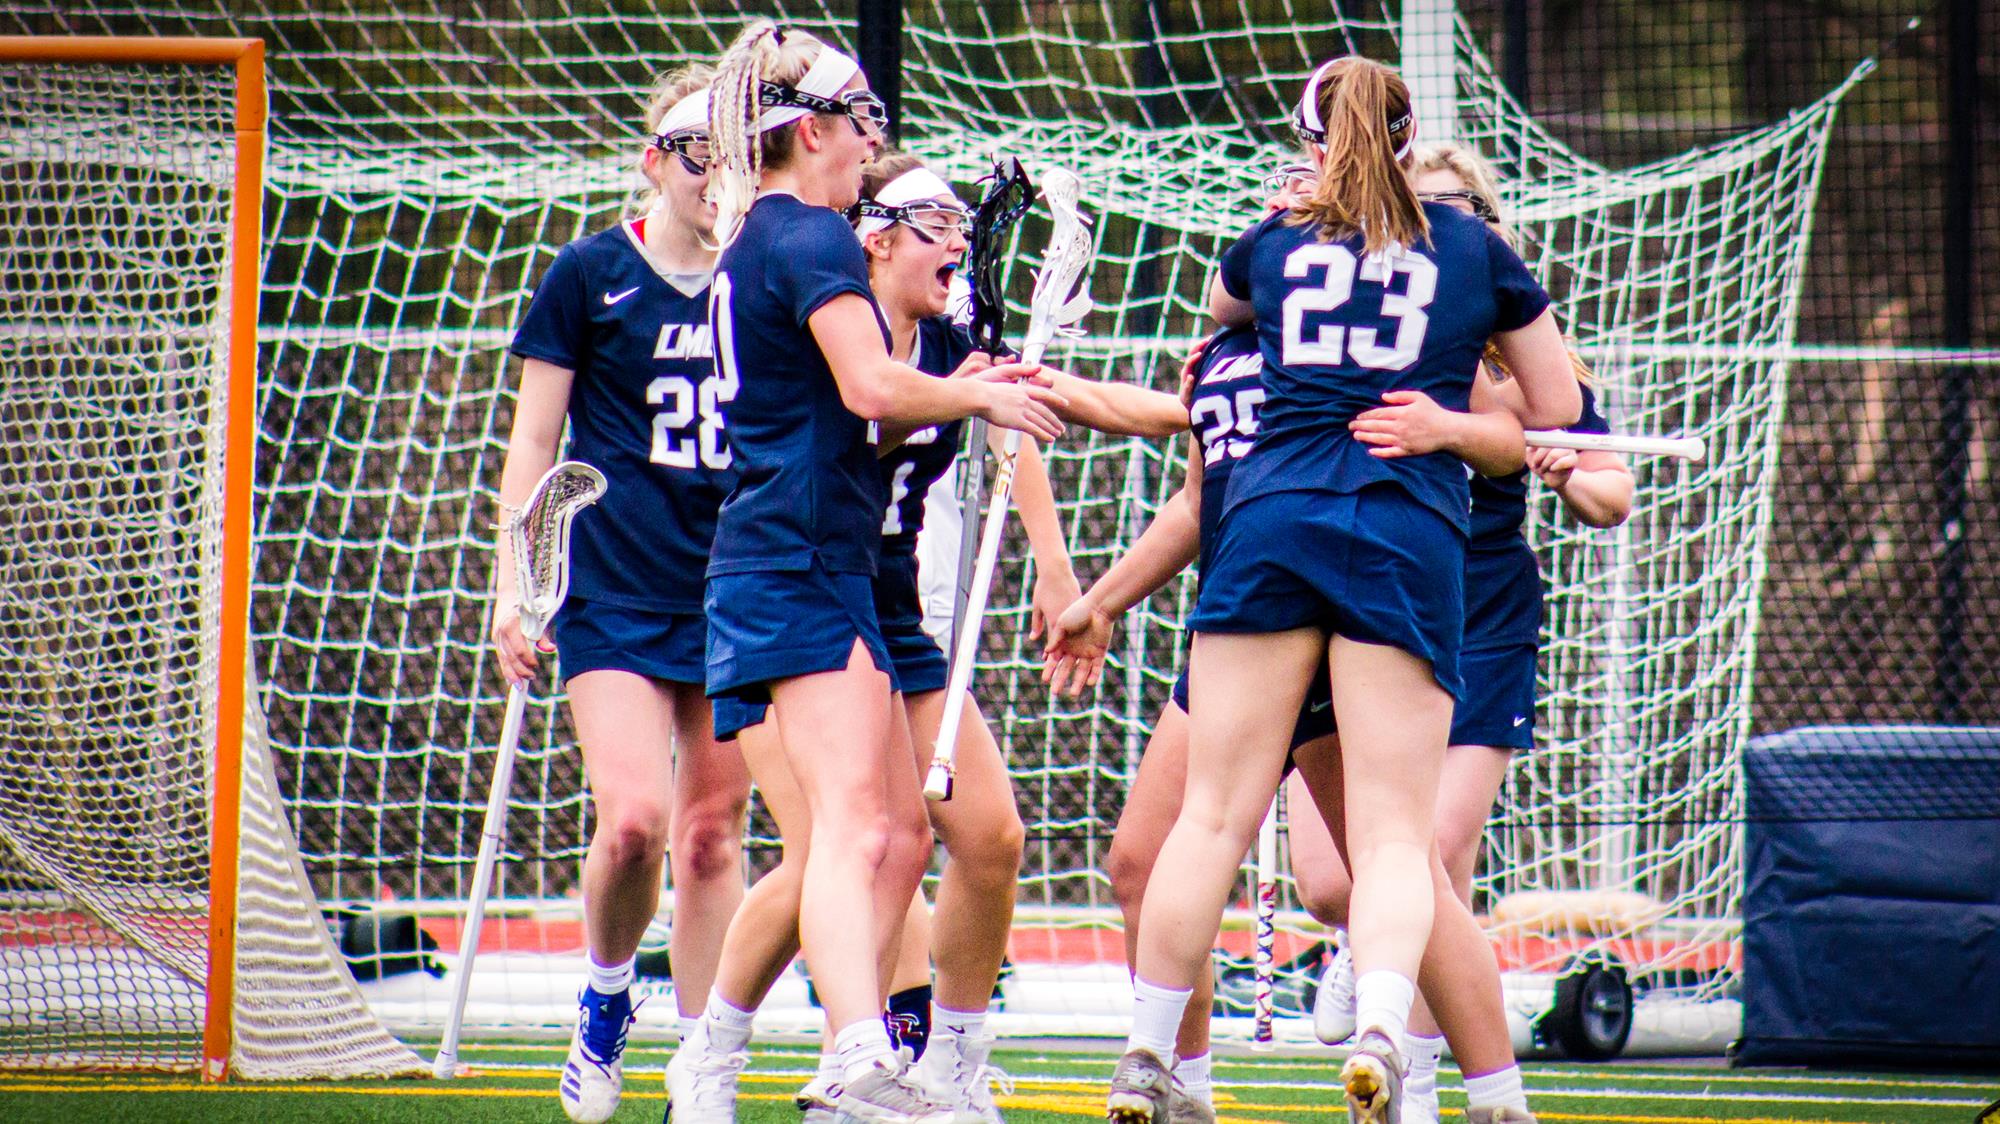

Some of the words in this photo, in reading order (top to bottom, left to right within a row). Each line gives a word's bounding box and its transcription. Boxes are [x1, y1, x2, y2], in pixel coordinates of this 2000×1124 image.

[760, 82, 784, 97] TX
[795, 92, 832, 111] STX
[1301, 128, 1317, 142] STX
[860, 205, 889, 217] STX
[1282, 243, 1439, 371] 23
[1200, 352, 1264, 385] LM
[646, 375, 733, 470] 28
[1190, 387, 1266, 467] 25
[966, 459, 982, 501] STX
